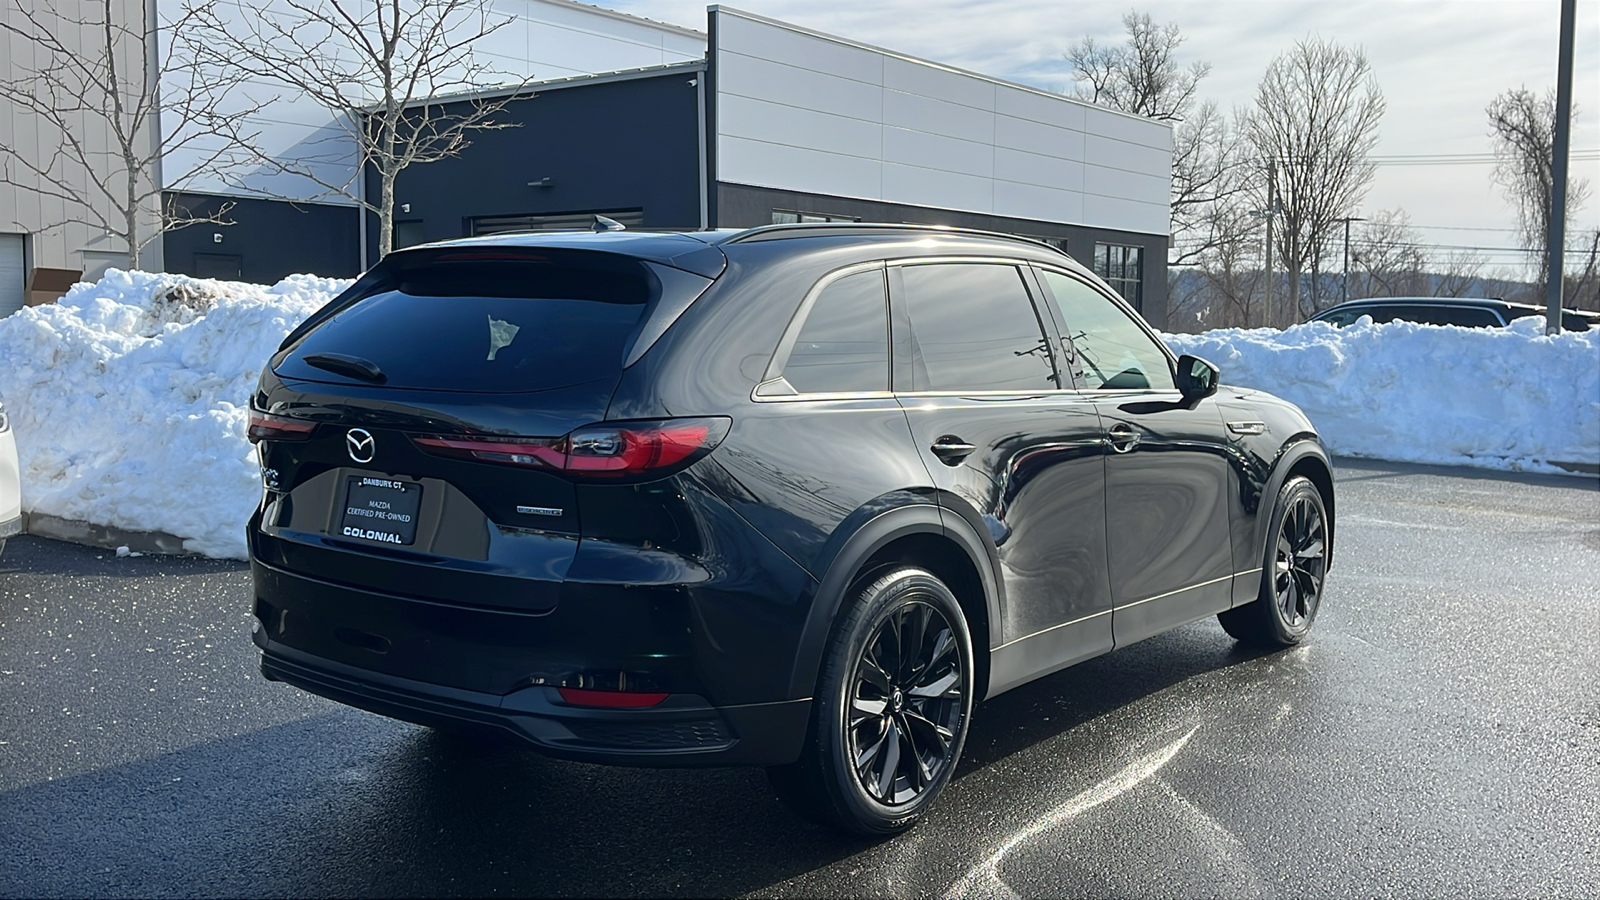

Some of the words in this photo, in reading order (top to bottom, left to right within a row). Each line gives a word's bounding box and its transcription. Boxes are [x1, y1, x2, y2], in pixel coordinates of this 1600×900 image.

[369, 500, 391, 510] MAZDA
[347, 507, 374, 518] CERTIFIED
[375, 511, 411, 523] PRE-OWNED
[343, 527, 402, 543] COLONIAL
